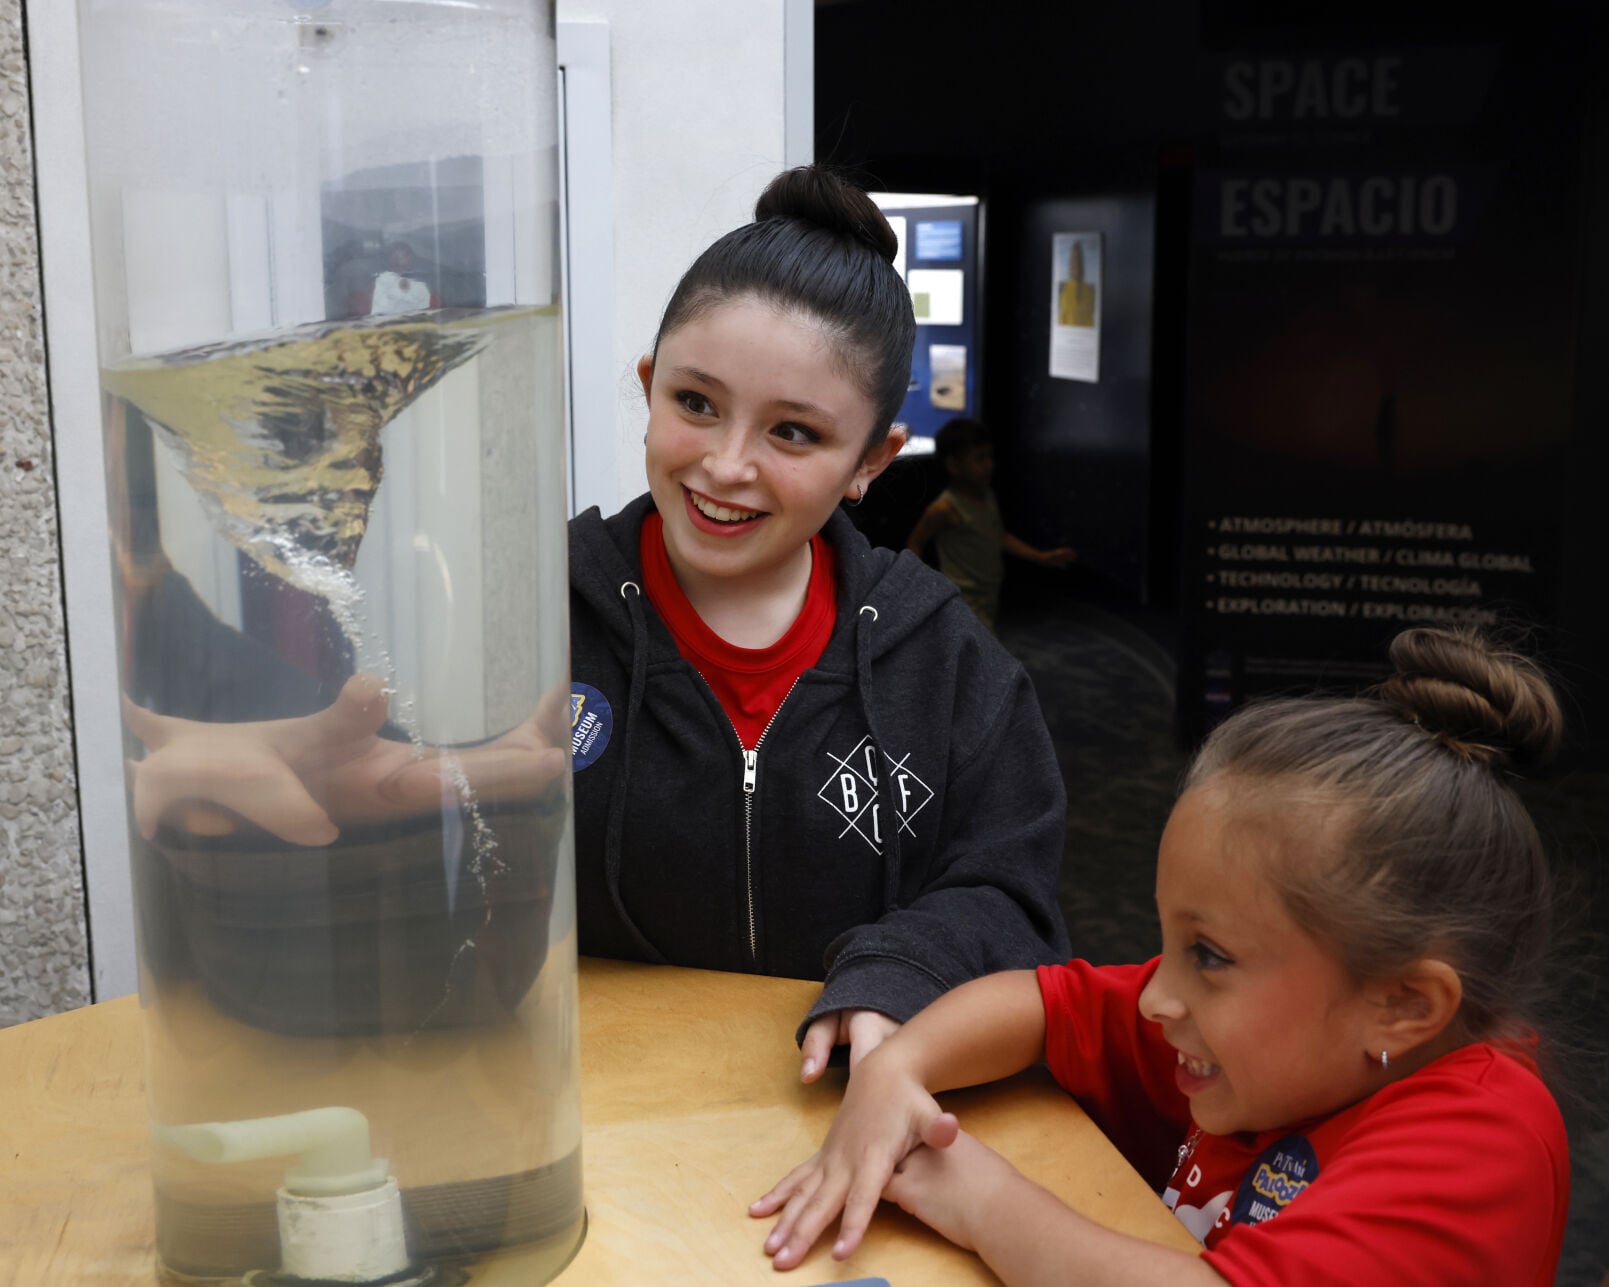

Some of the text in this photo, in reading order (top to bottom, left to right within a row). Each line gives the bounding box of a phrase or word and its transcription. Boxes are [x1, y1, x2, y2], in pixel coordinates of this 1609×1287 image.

[1223, 56, 1402, 120] SPACE
[1220, 174, 1457, 238] ESPACIO
[1219, 517, 1342, 537] ATMOSPHERE
[1358, 519, 1474, 541] ATMÓSFERA
[1217, 544, 1288, 562] GLOBAL
[1293, 546, 1380, 565] WEATHER
[1395, 550, 1454, 568] CLIMA
[1457, 553, 1534, 573] GLOBAL
[1218, 570, 1342, 591] TECHNOLOGY
[1359, 575, 1483, 597] TECNOLOGÍA
[1216, 596, 1346, 617] EXPLORATION
[580, 721, 604, 757] ADMISSION
[840, 772, 912, 814] B F
[1249, 1200, 1280, 1223] MUSE
